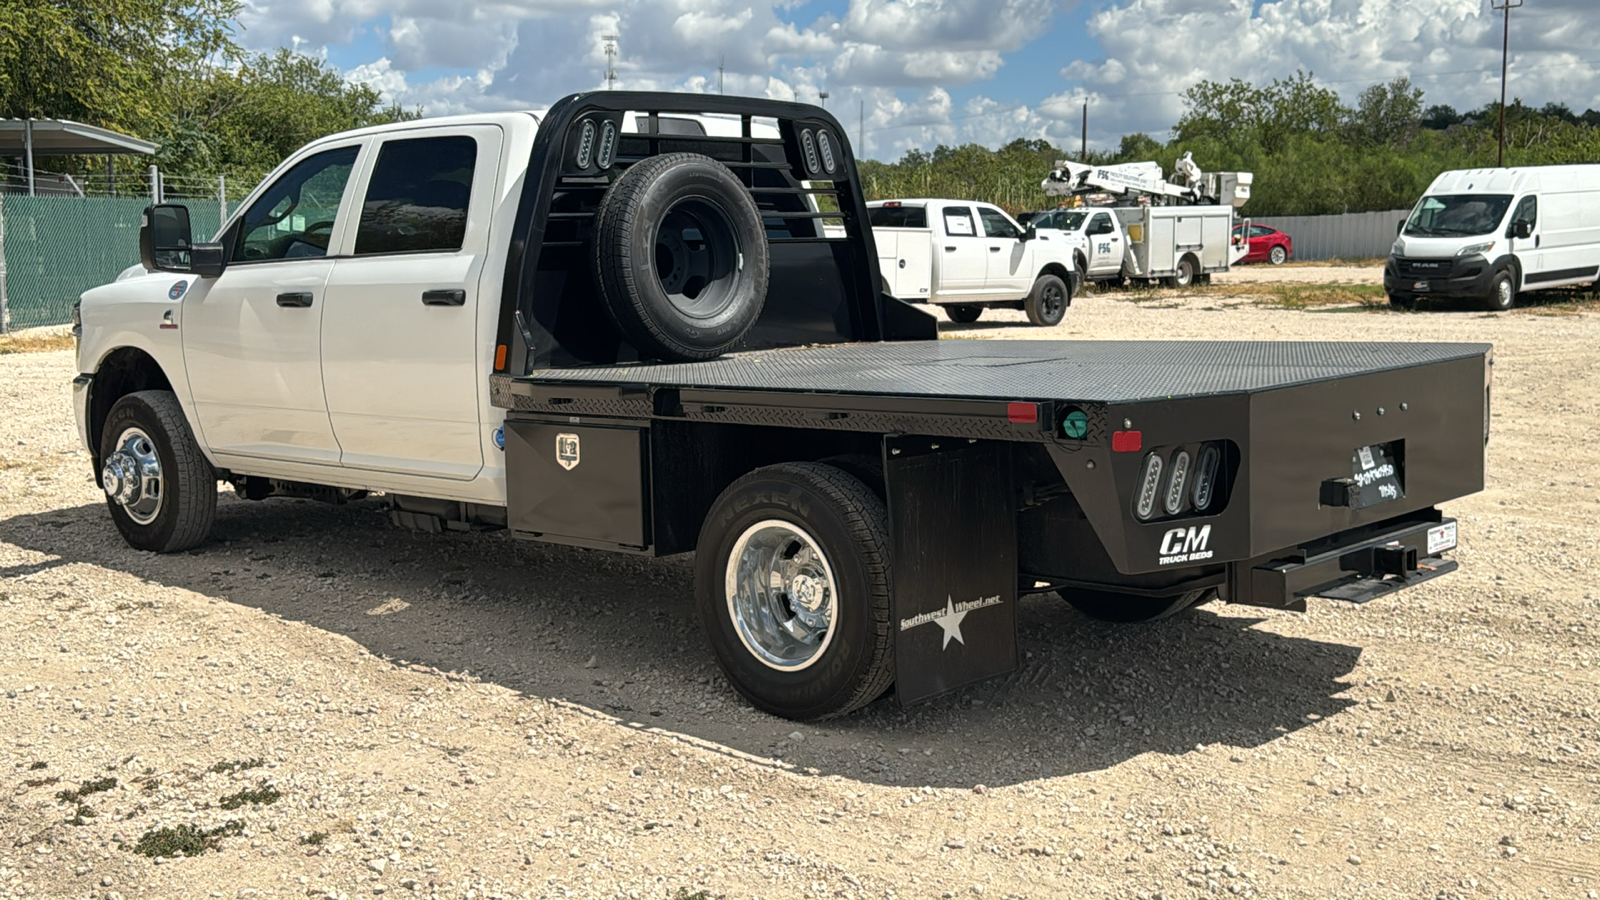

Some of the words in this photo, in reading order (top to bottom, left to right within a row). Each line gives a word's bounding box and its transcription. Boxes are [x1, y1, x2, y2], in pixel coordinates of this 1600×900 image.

[1097, 169, 1109, 180] FSG
[1098, 242, 1111, 254] FSG
[719, 491, 811, 528] NEXEN
[1159, 524, 1212, 555] CM
[1158, 554, 1189, 565] TRUCK
[1189, 550, 1213, 561] BEDS
[900, 607, 947, 629] Southwest
[954, 595, 1002, 613] Wheel.net
